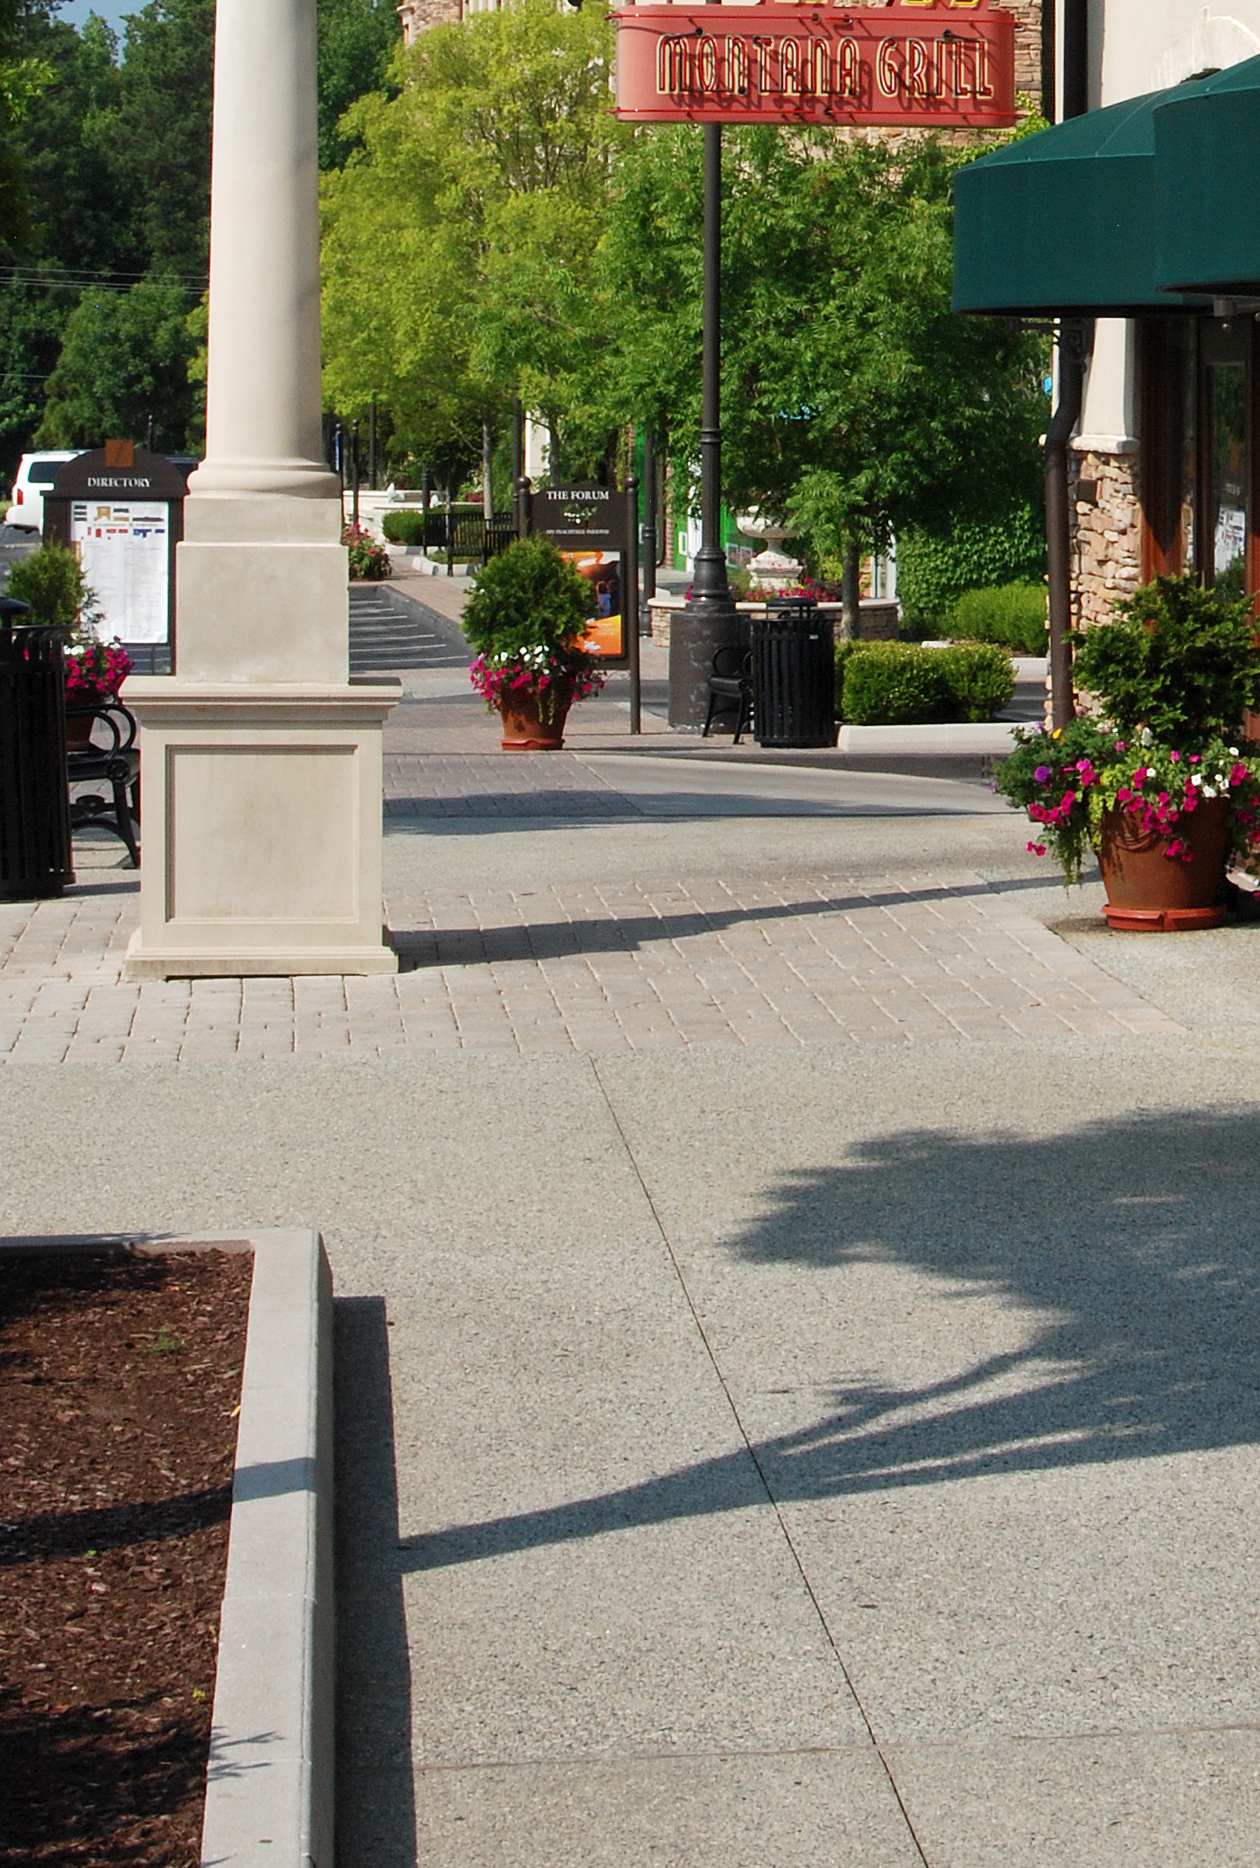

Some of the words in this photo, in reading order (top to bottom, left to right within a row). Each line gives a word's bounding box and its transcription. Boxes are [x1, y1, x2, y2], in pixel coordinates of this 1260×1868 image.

[656, 34, 860, 98] MONTANA
[875, 37, 995, 100] GRILL
[86, 476, 152, 488] DIRECTORY
[546, 490, 569, 501] THE
[570, 490, 610, 501] FORUM
